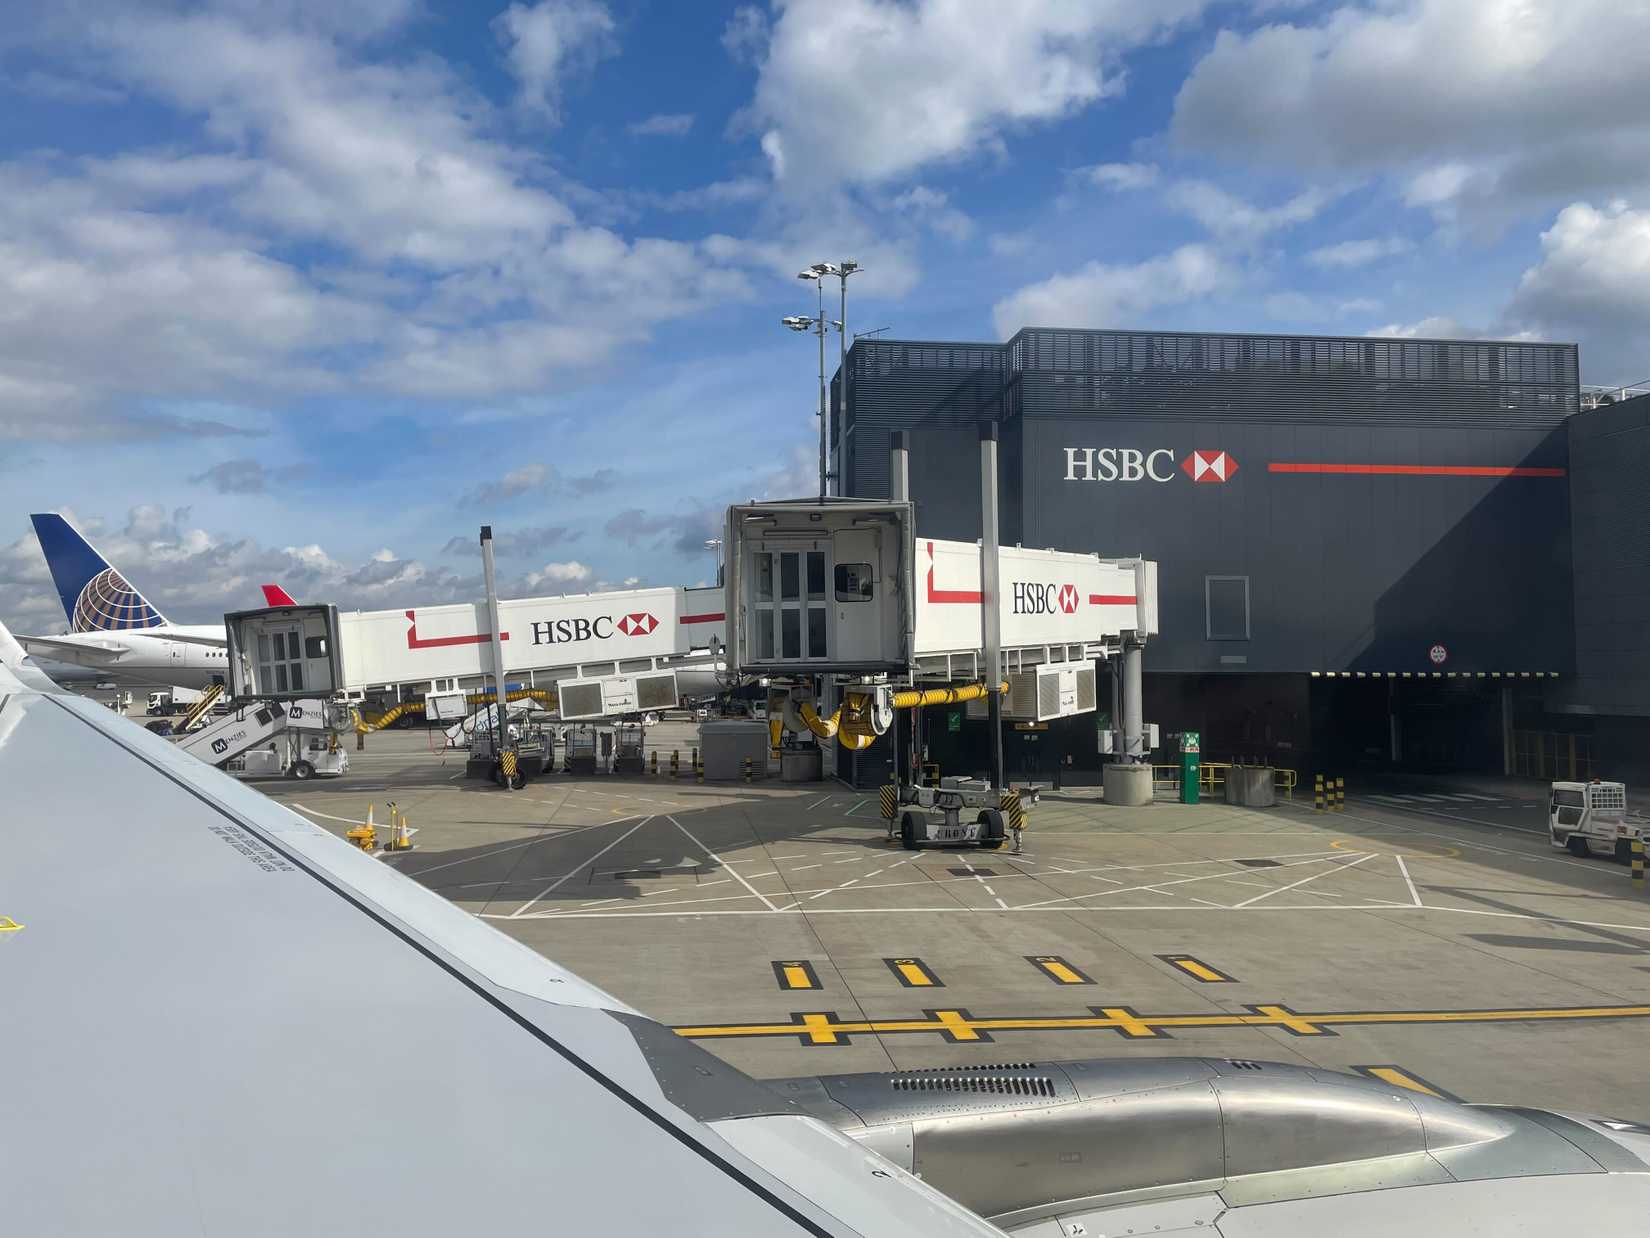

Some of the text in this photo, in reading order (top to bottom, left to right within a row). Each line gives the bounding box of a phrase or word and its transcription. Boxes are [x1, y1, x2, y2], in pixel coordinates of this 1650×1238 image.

[1063, 447, 1176, 482] HSBC
[1012, 582, 1057, 614] HSBC
[530, 616, 614, 645] HSBC
